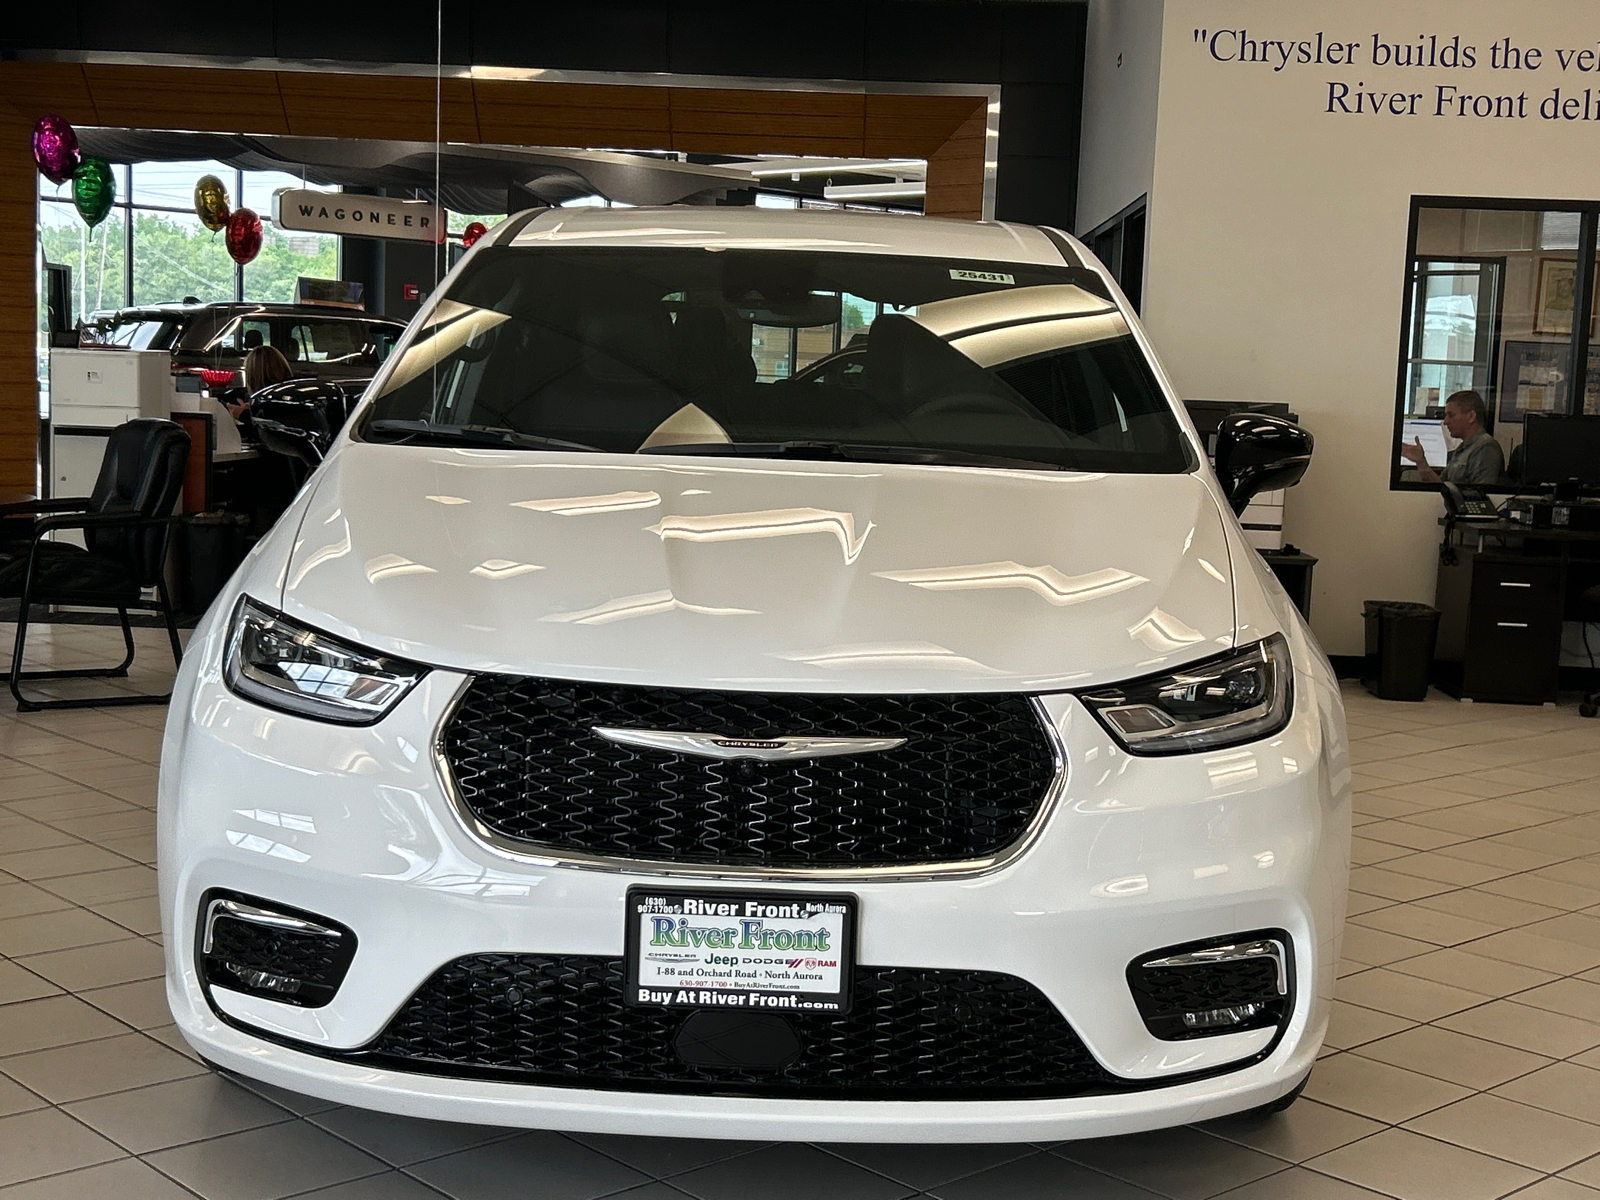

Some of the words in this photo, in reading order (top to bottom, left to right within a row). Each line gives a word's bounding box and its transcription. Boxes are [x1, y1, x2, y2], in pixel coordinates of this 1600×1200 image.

[1193, 29, 1360, 72] "Chrysler
[1371, 34, 1477, 68] builds
[1490, 37, 1542, 70] the
[1554, 41, 1600, 73] ve
[1324, 81, 1423, 115] River
[1433, 85, 1528, 119] Front
[298, 204, 430, 228] WAGONEER
[958, 271, 1005, 281] 25431
[645, 897, 666, 906] (630)
[805, 902, 824, 913] North
[824, 904, 847, 914] Aurora
[637, 904, 673, 914] 907-1700
[683, 899, 738, 916] River
[745, 901, 800, 918] Front
[650, 916, 738, 948] River
[738, 919, 831, 952] Front
[704, 953, 739, 967] Jeep
[817, 960, 837, 968] RAM
[657, 967, 676, 976] I-88
[677, 968, 694, 977] and
[696, 968, 732, 978] Orchard
[735, 969, 757, 978] Road
[764, 970, 790, 980] North
[792, 971, 823, 980] Aurora
[679, 980, 728, 988] 630-907-1700
[734, 982, 800, 990] BuyAtRiverFront.com
[638, 989, 673, 1005] Buy
[675, 990, 697, 1004] At
[699, 991, 746, 1005] River
[749, 993, 839, 1010] Front.com
